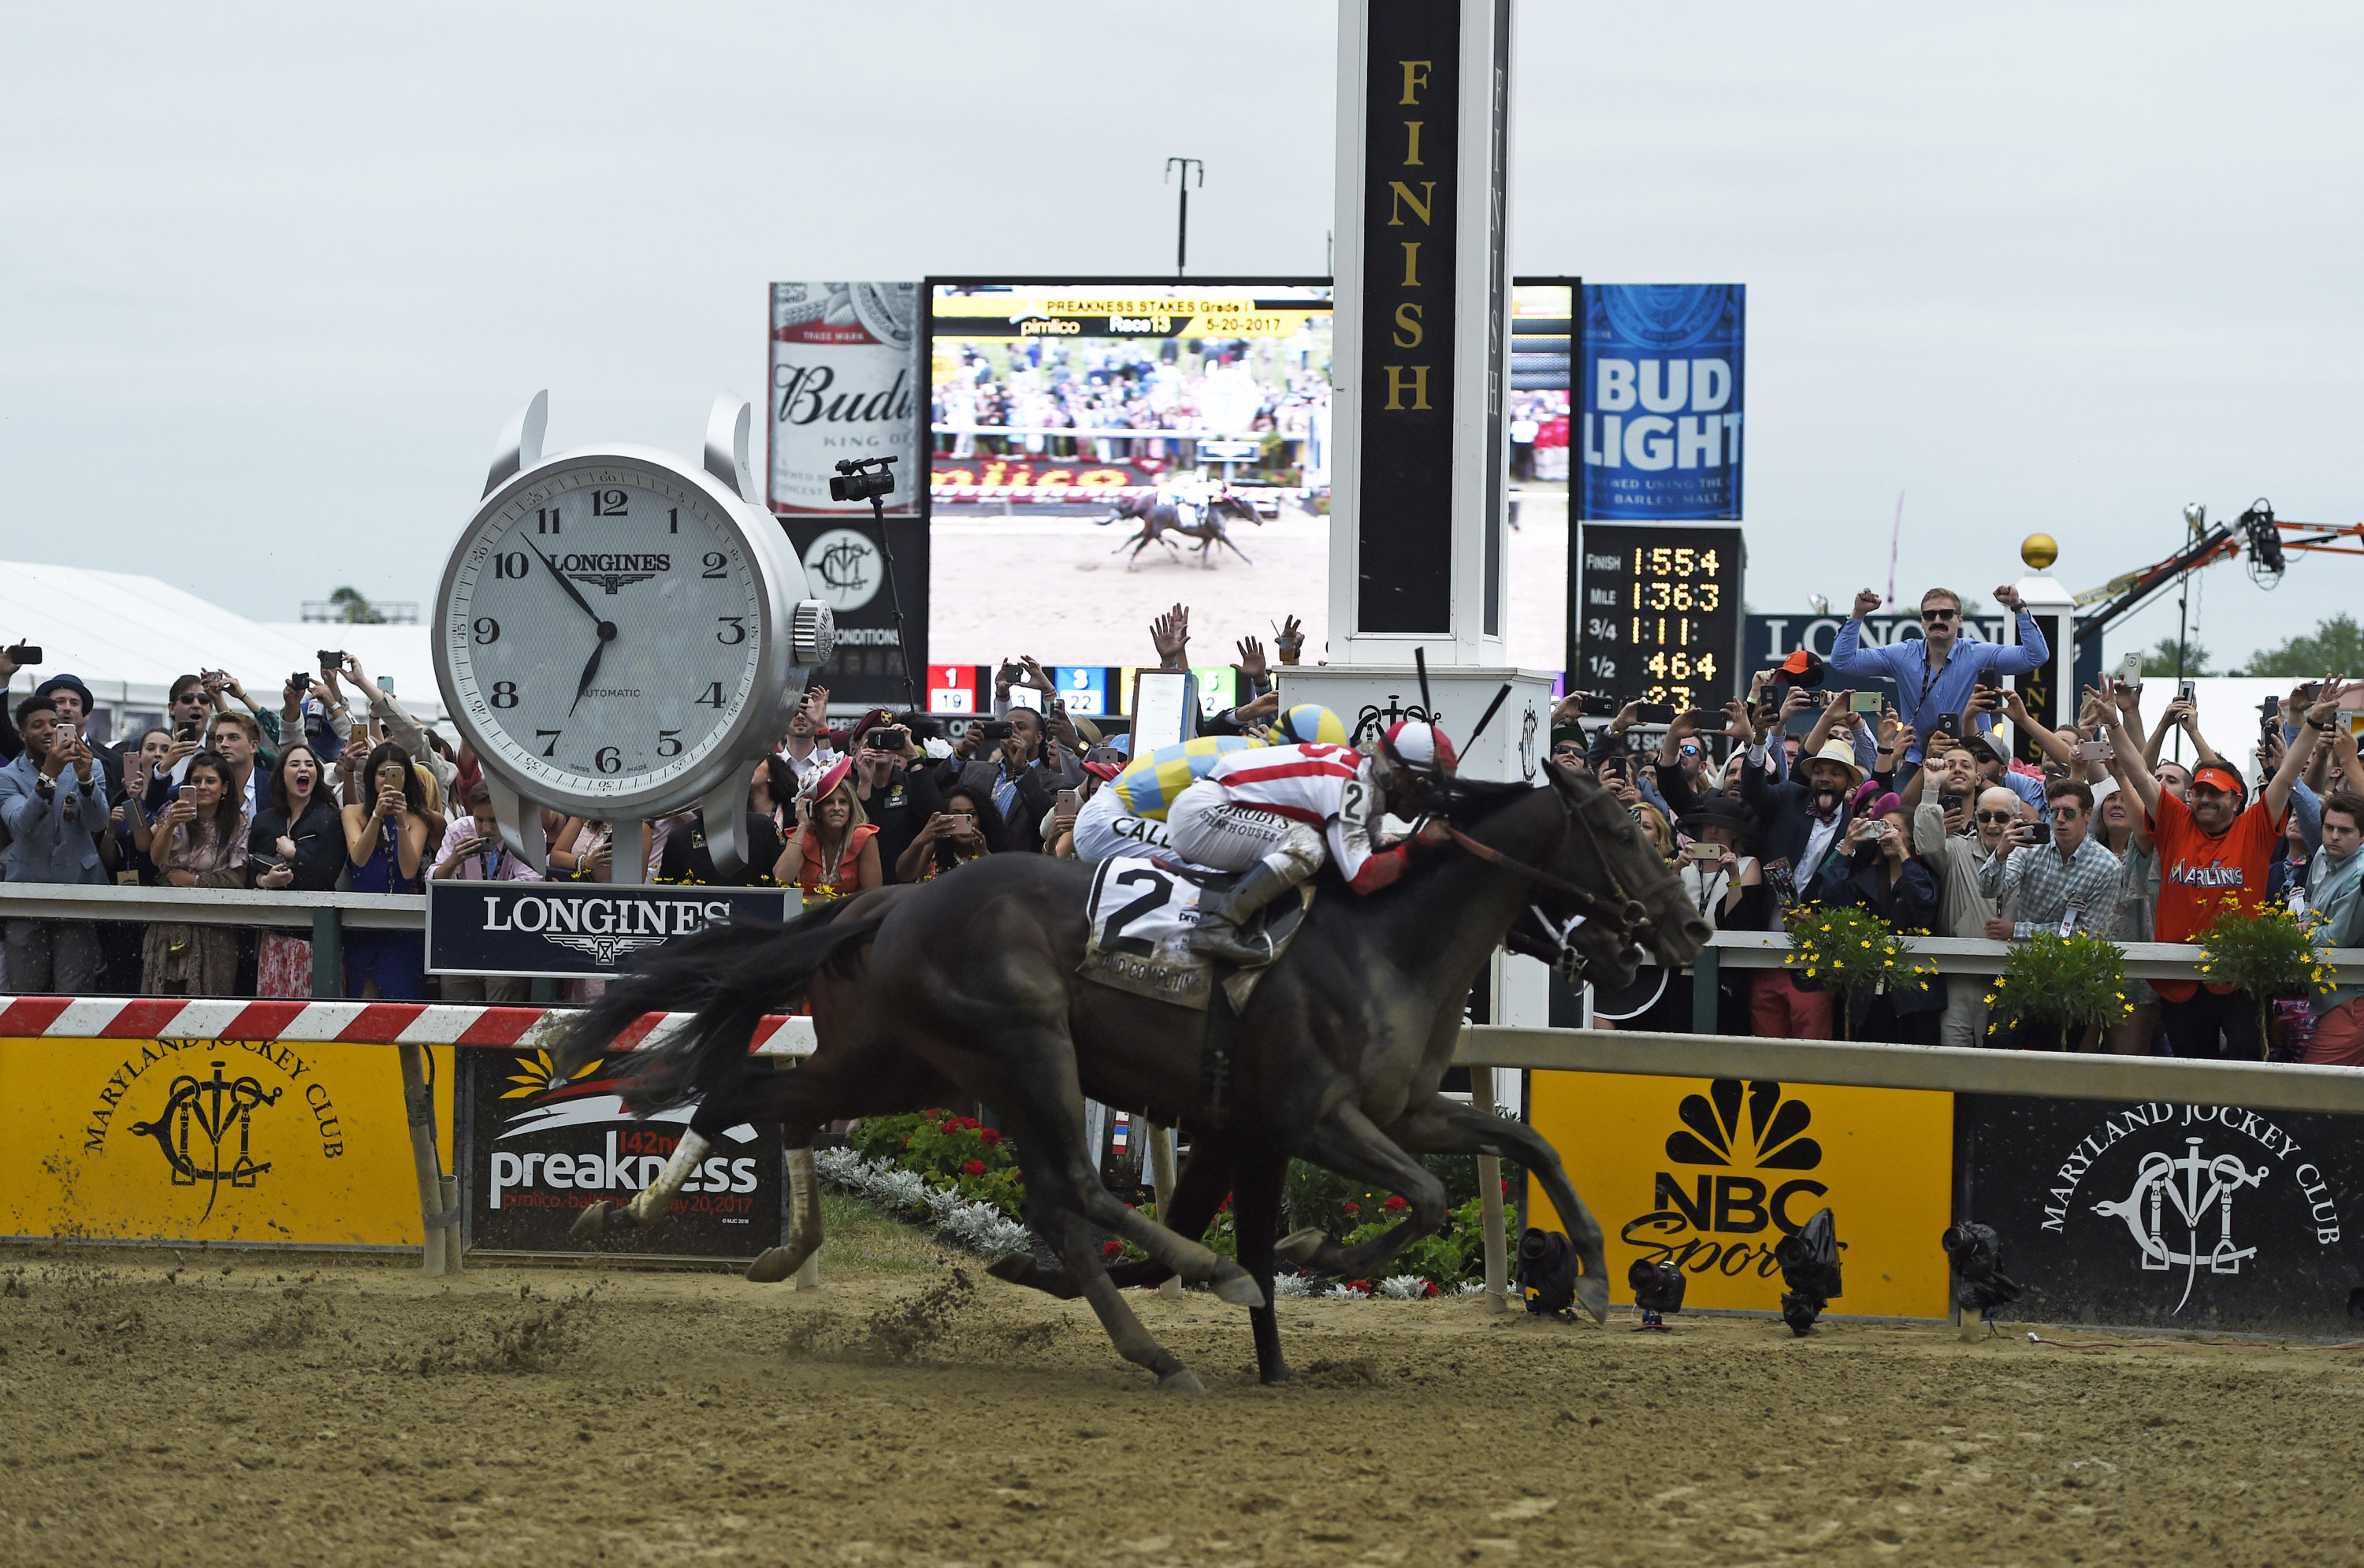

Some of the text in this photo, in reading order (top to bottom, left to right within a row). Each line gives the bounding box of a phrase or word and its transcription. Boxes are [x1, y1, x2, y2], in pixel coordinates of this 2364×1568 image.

[1384, 61, 1437, 411] FINISH
[1489, 68, 1503, 416] FINISH
[1047, 302, 1134, 311] PREAKNESS
[1139, 302, 1195, 311] STAKES
[1201, 302, 1240, 312] Grade
[804, 332, 865, 340] TRADE MARK
[1021, 315, 1080, 336] pimlico
[1206, 319, 1280, 331] 5-20-2017
[1597, 359, 1730, 413] BUD
[824, 435, 879, 447] KING
[1584, 412, 1744, 471] LIGHT
[536, 489, 678, 533] 11 12 1
[492, 552, 529, 578] 10
[549, 554, 670, 571] LONGINES
[702, 552, 727, 578] 2
[1586, 553, 1621, 571] FINISH
[1590, 588, 1616, 605] MILE
[474, 617, 745, 645] 9 3
[1589, 618, 1618, 641] 3/4
[946, 667, 957, 688] 1
[1073, 669, 1087, 689] 3
[1589, 655, 1615, 678] 1/2
[491, 681, 519, 708] 8
[694, 682, 727, 708] 4
[942, 693, 1216, 712] 19 3 22 2
[536, 729, 682, 774] 7 6 5
[571, 764, 649, 773] SWISS MADE
[1345, 784, 1363, 820] 2
[2169, 857, 2243, 887] MARLINS
[483, 897, 730, 935] LONGINES
[1100, 869, 1173, 957] 2
[306, 1083, 344, 1160] CLUB
[490, 1131, 757, 1209] preakness
[2041, 1102, 2340, 1245] MARYLAND JOCKEY CLUB
[1655, 1172, 1829, 1235] NBC
